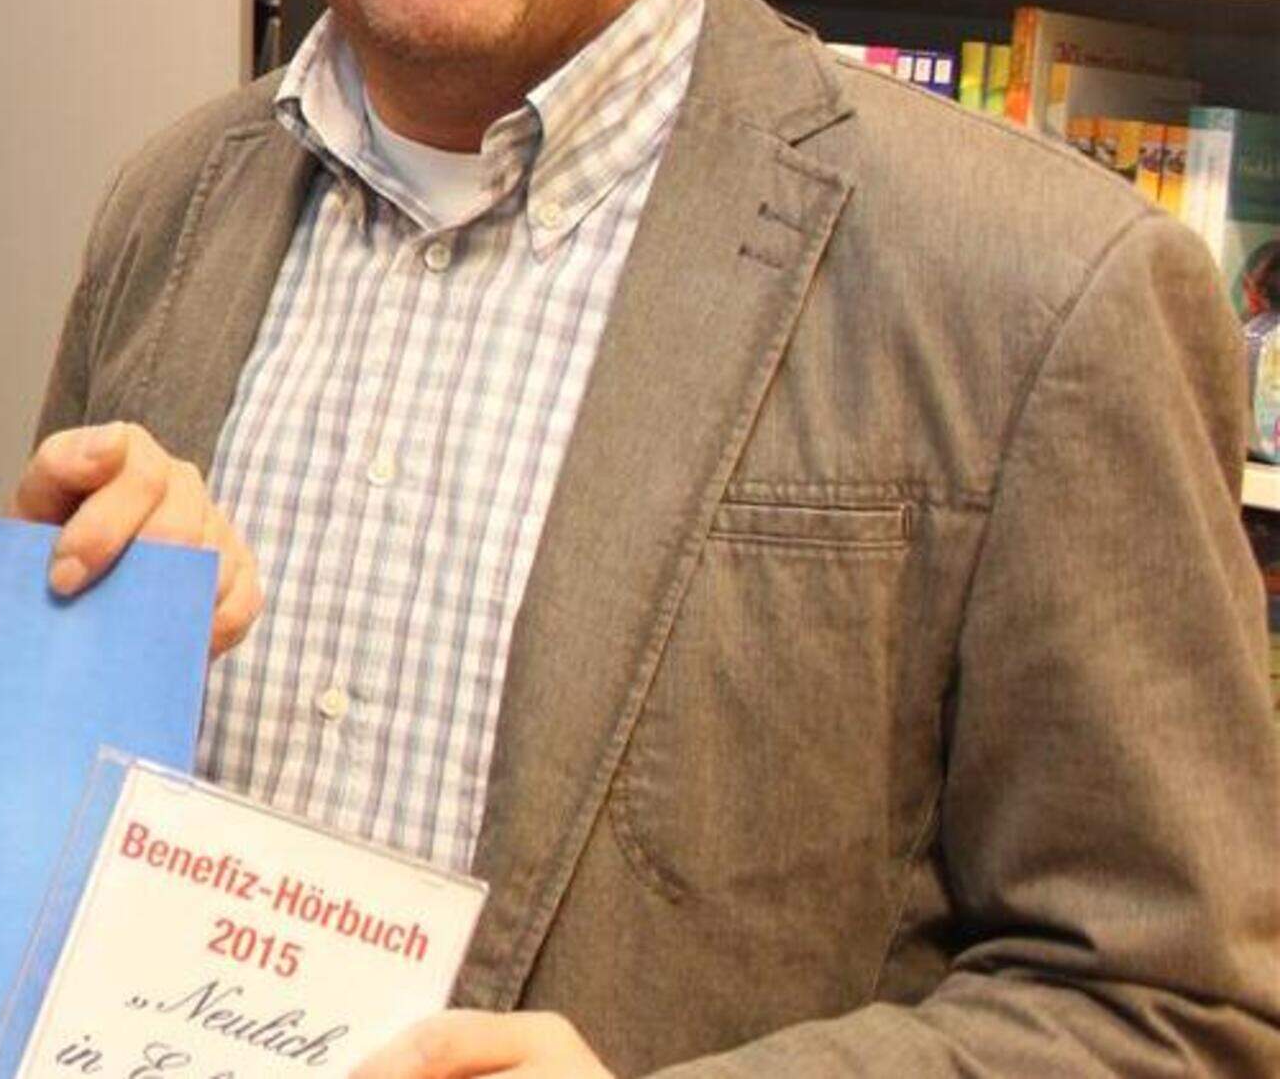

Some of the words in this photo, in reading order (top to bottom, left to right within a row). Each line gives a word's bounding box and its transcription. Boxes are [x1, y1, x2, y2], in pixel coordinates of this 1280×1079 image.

[118, 822, 431, 963] Benefiz-Hörbuch
[206, 917, 305, 980] 2015
[54, 1034, 104, 1074] in
